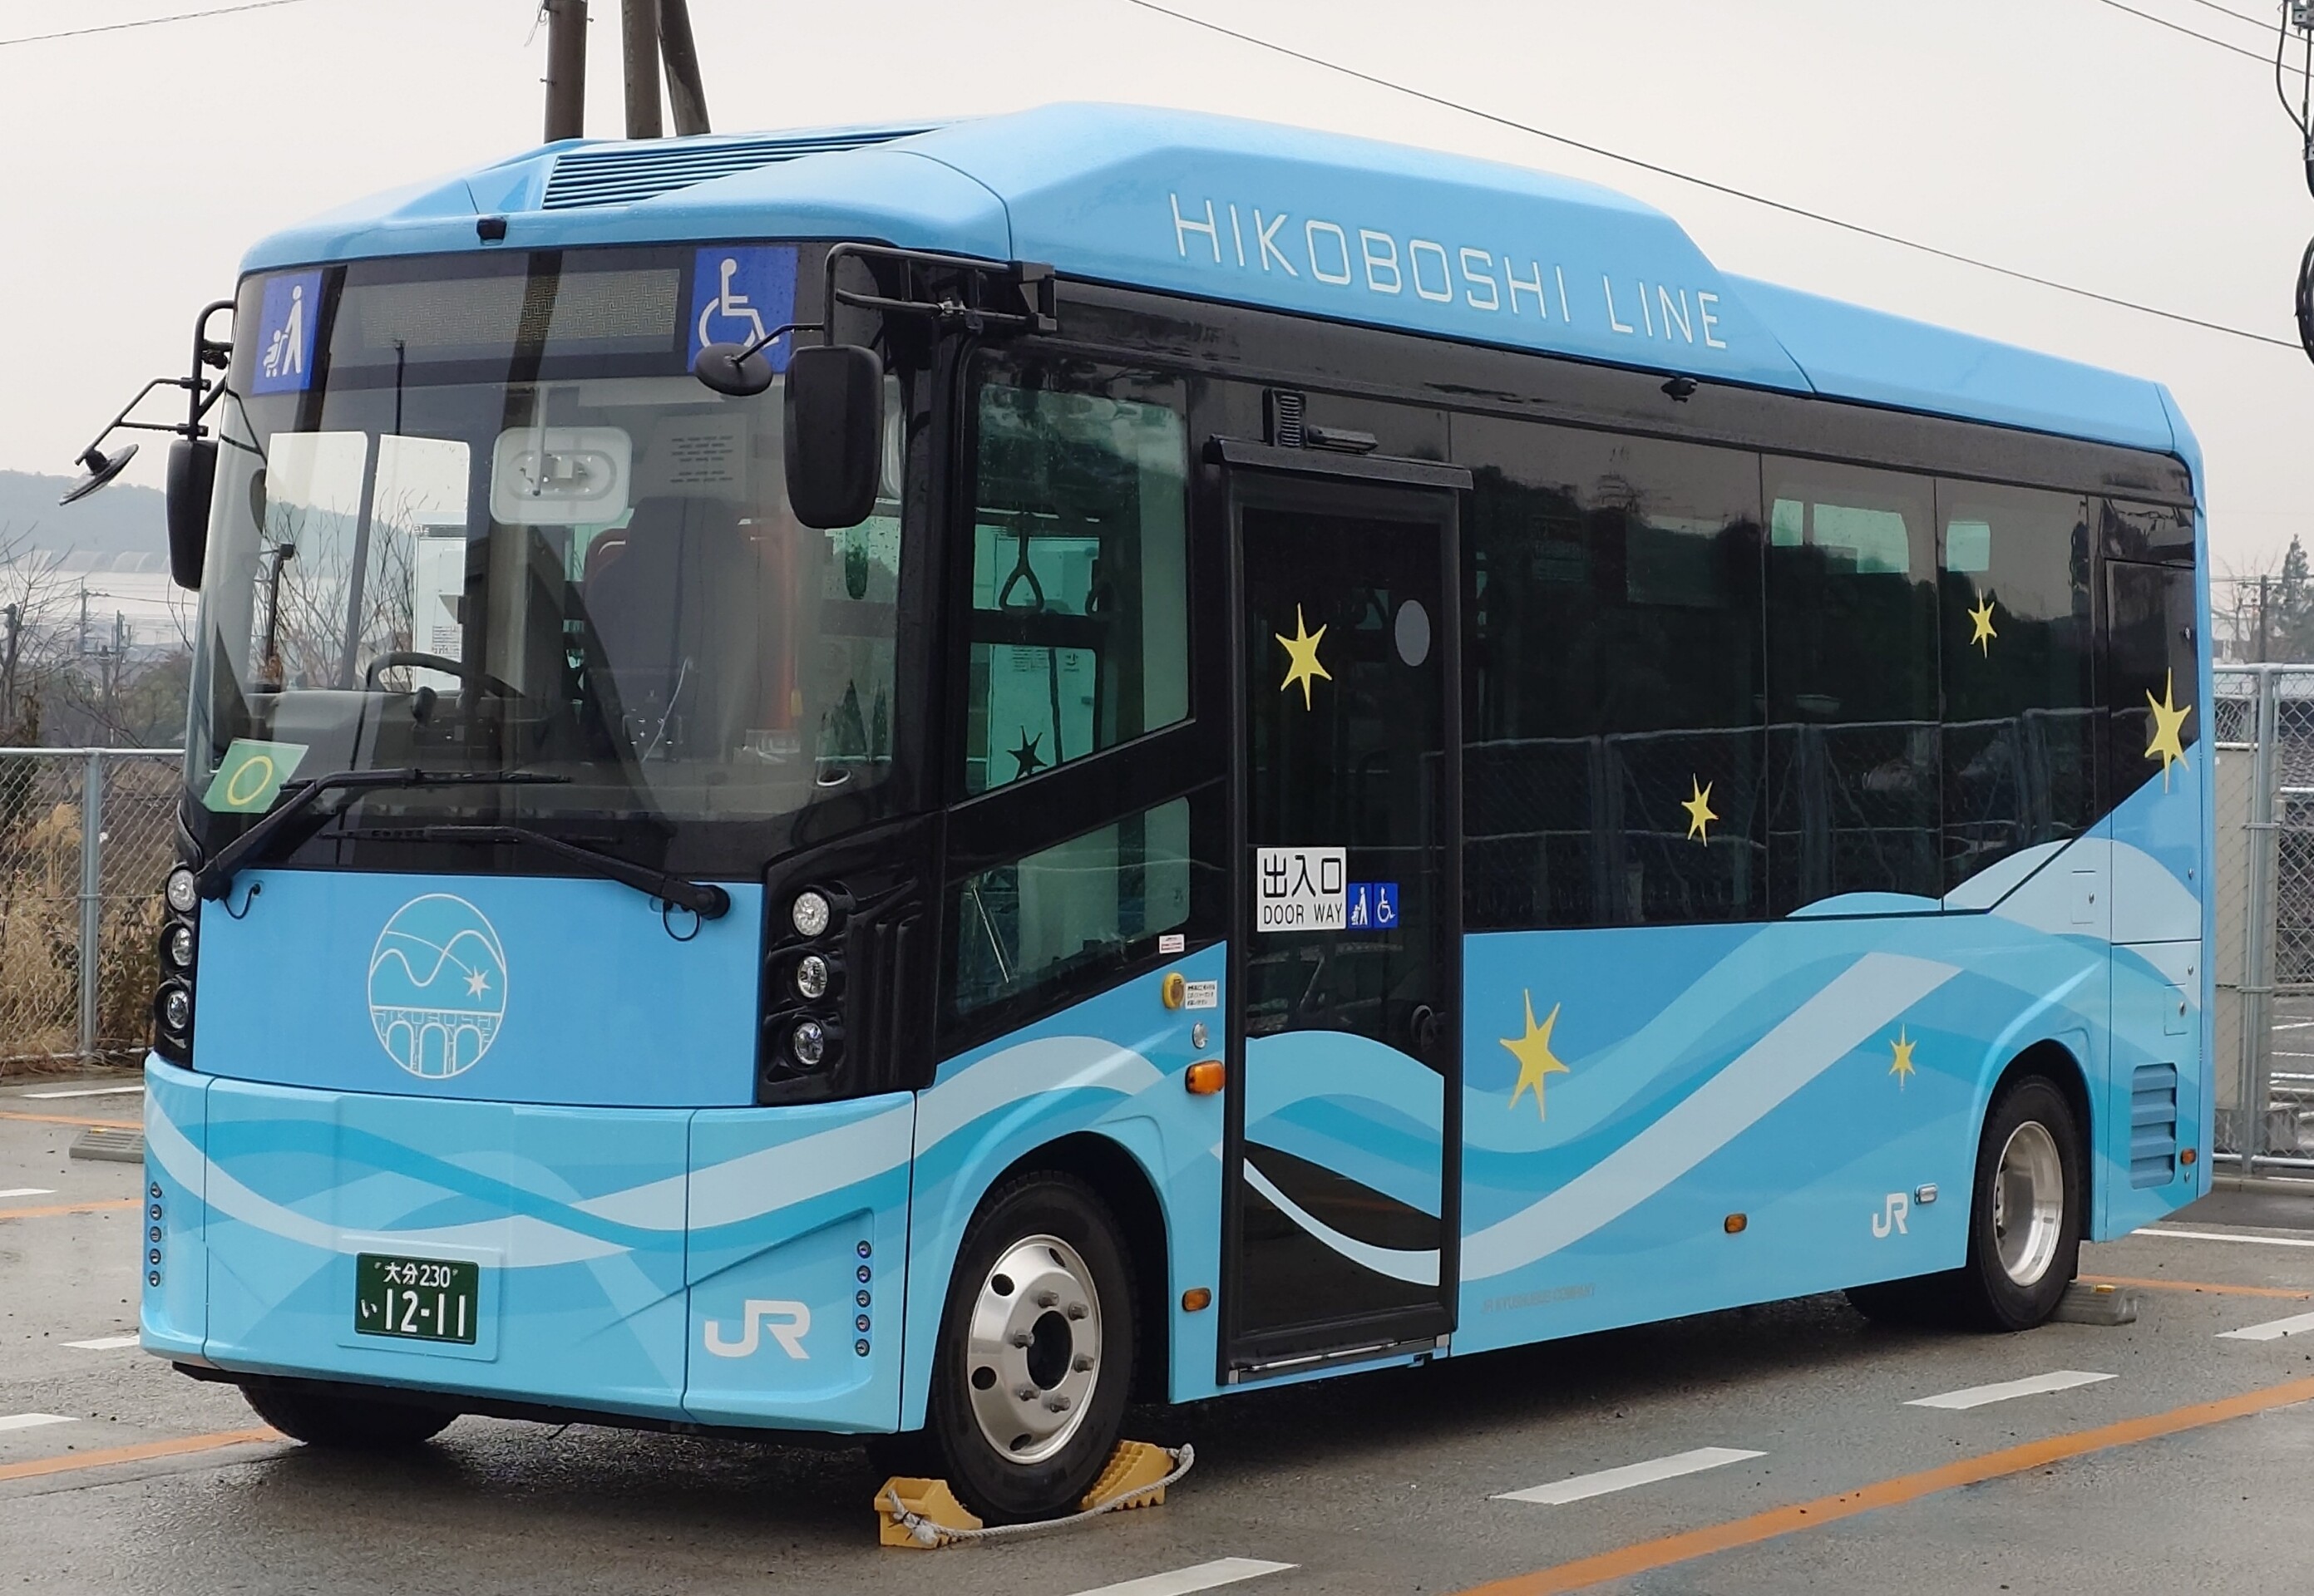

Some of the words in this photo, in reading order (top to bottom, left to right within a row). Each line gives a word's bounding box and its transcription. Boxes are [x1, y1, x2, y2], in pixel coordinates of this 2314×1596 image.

[1169, 192, 1571, 323] HIKOBOSHI
[1601, 273, 1728, 349] LINE
[1263, 853, 1342, 898] 出入口
[1263, 904, 1305, 924] DOOR
[1314, 902, 1343, 923] WAY
[1872, 1193, 1907, 1238] JR
[382, 1262, 451, 1288] 大分230
[360, 1298, 377, 1319] い
[385, 1288, 466, 1337] 12-11
[704, 1298, 811, 1359] JR
